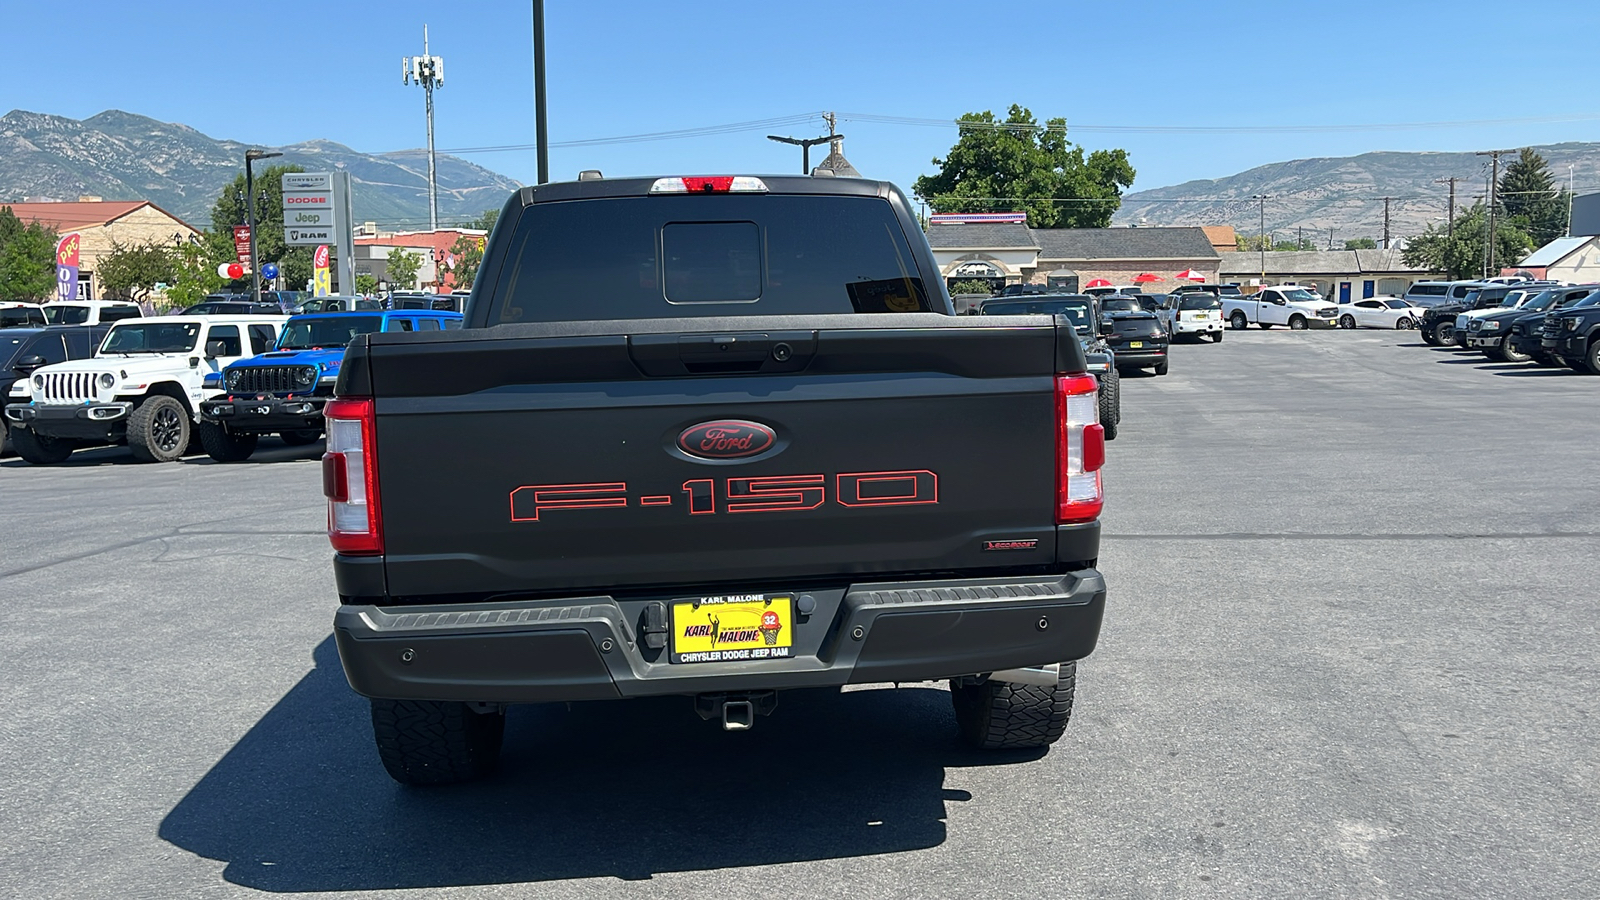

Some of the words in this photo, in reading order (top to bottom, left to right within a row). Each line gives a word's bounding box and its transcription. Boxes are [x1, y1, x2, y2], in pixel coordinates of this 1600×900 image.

[295, 212, 320, 224] Jeep
[59, 237, 79, 264] PRE
[58, 268, 71, 301] OW
[700, 427, 754, 451] Ford
[509, 469, 939, 523] F-150
[700, 597, 725, 605] KARL
[727, 594, 764, 603] MALONE
[764, 615, 776, 625] 32
[684, 625, 711, 637] KARL
[717, 630, 759, 643] MALONE
[680, 652, 721, 662] CHRYSLER
[722, 649, 750, 659] DODGE
[750, 648, 770, 658] JEEP
[770, 647, 789, 657] RAM
